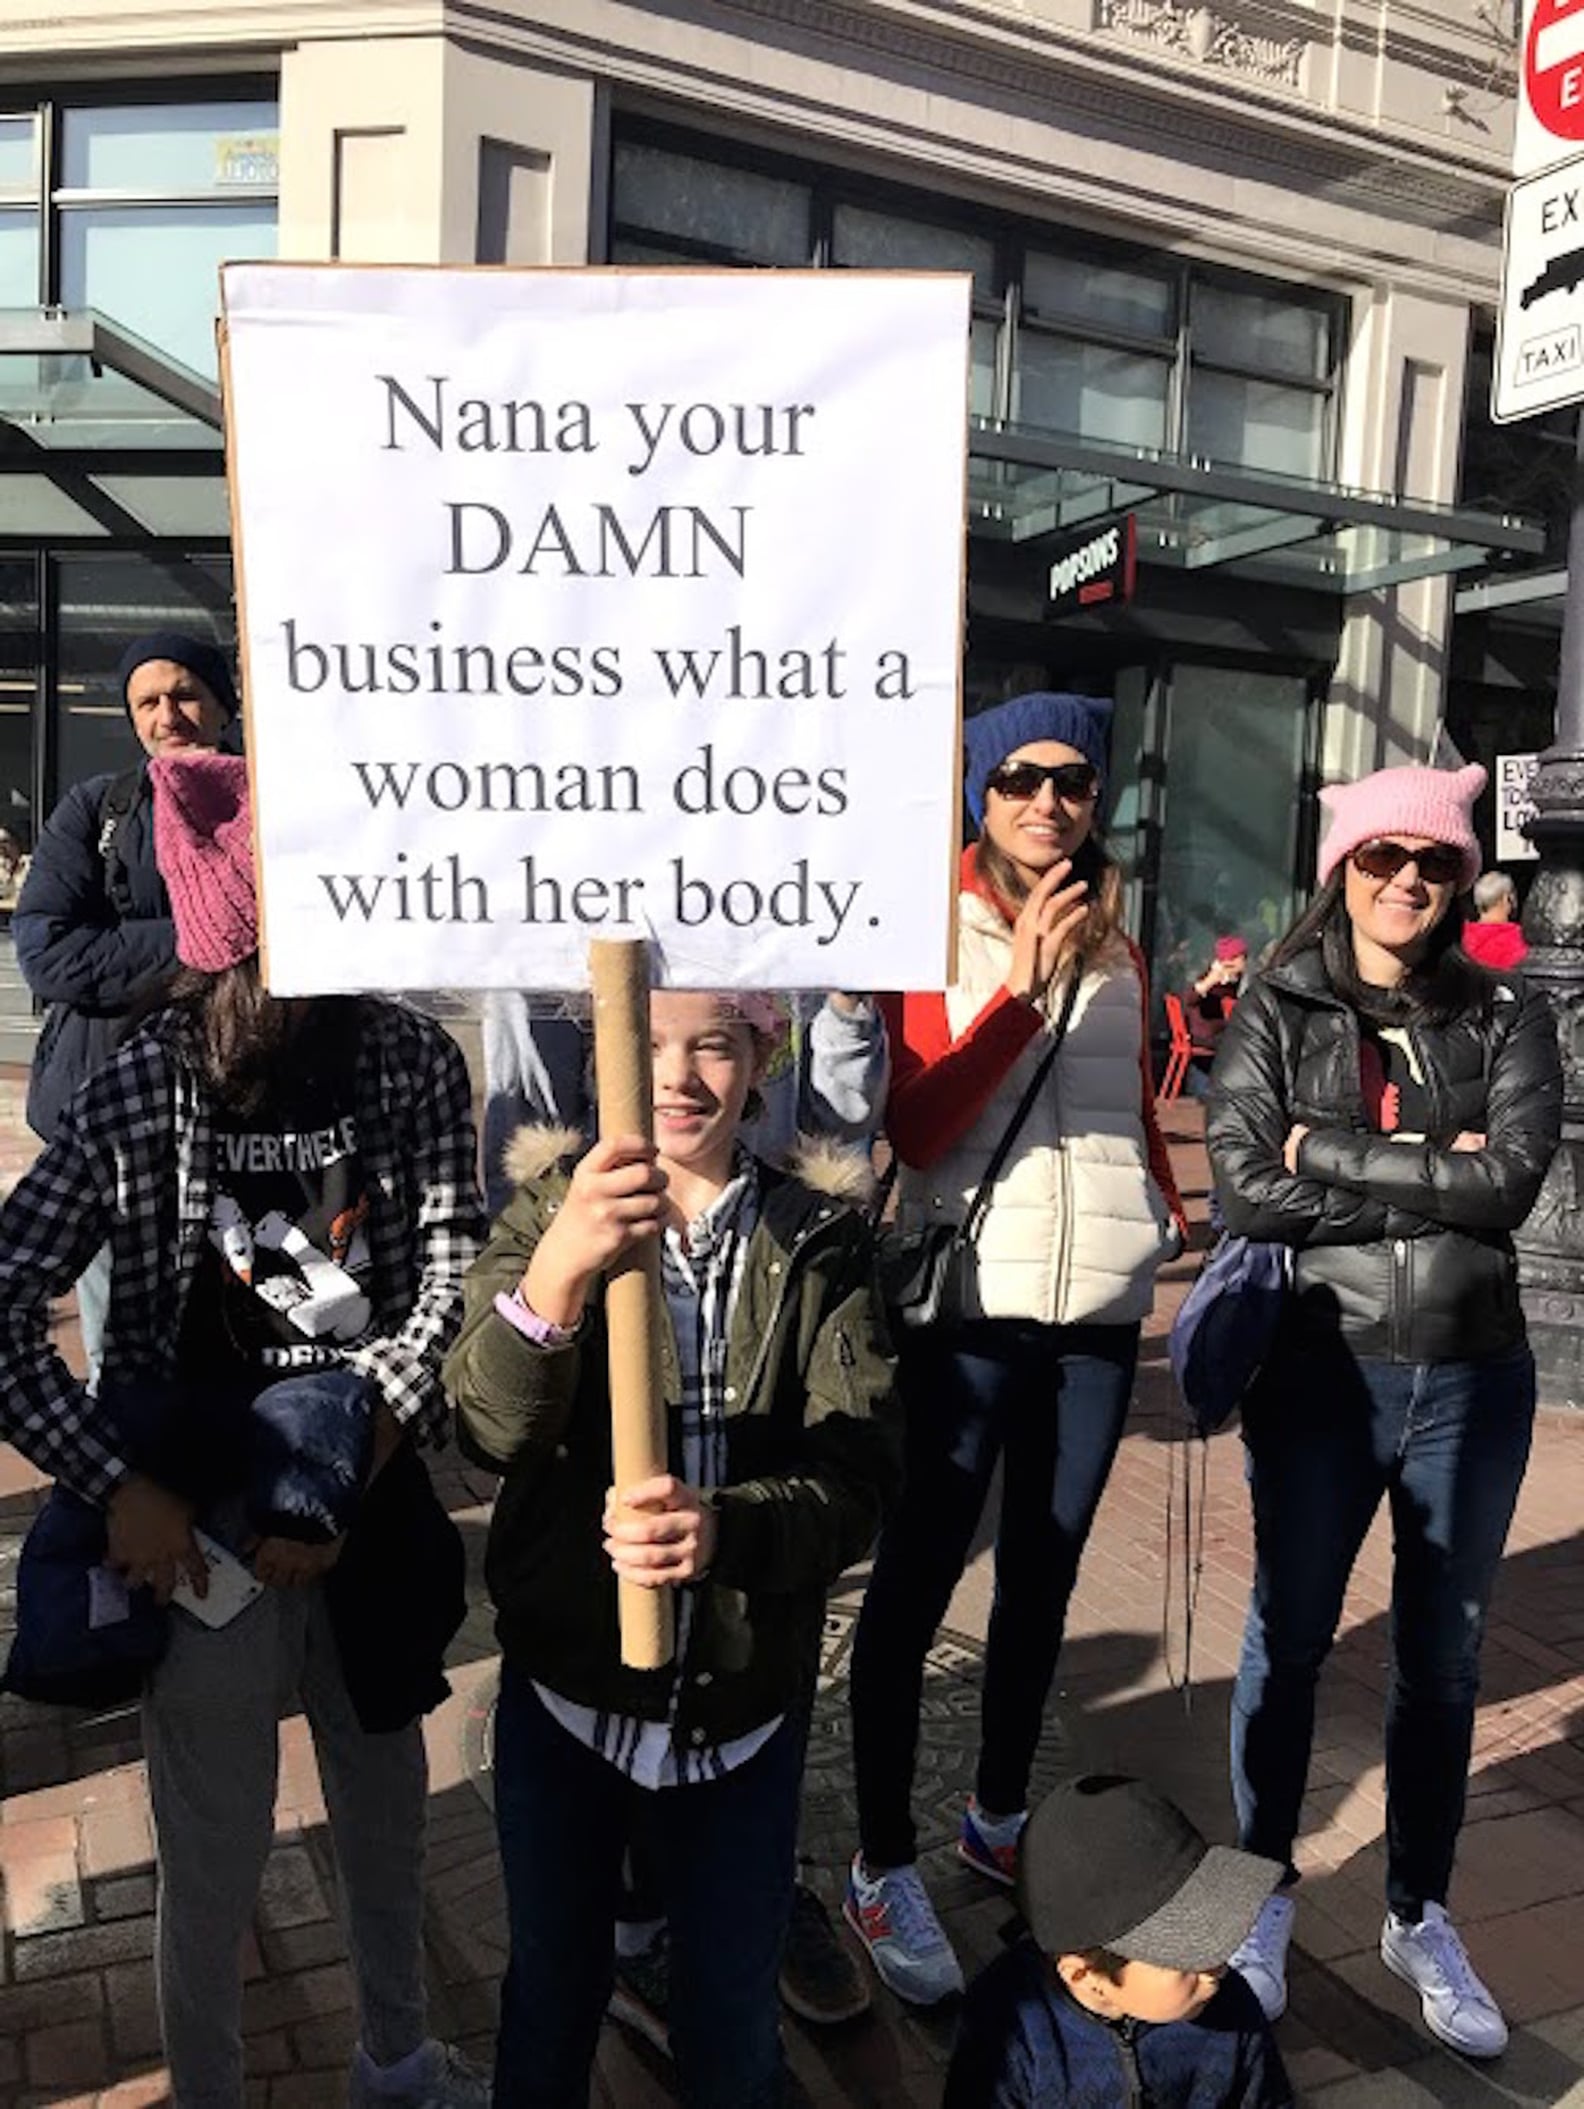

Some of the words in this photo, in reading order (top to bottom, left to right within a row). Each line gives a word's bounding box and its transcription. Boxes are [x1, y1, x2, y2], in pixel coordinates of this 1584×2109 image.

[1524, 337, 1575, 373] TAXI
[375, 374, 599, 454] Nana
[625, 402, 816, 476] your
[443, 502, 753, 578] DAMN
[281, 618, 623, 697] business
[653, 624, 848, 699] what
[873, 648, 915, 700] a
[350, 760, 644, 813] woman
[672, 743, 849, 816] does
[317, 853, 492, 922] with
[519, 855, 645, 925] her
[668, 856, 881, 946] body.
